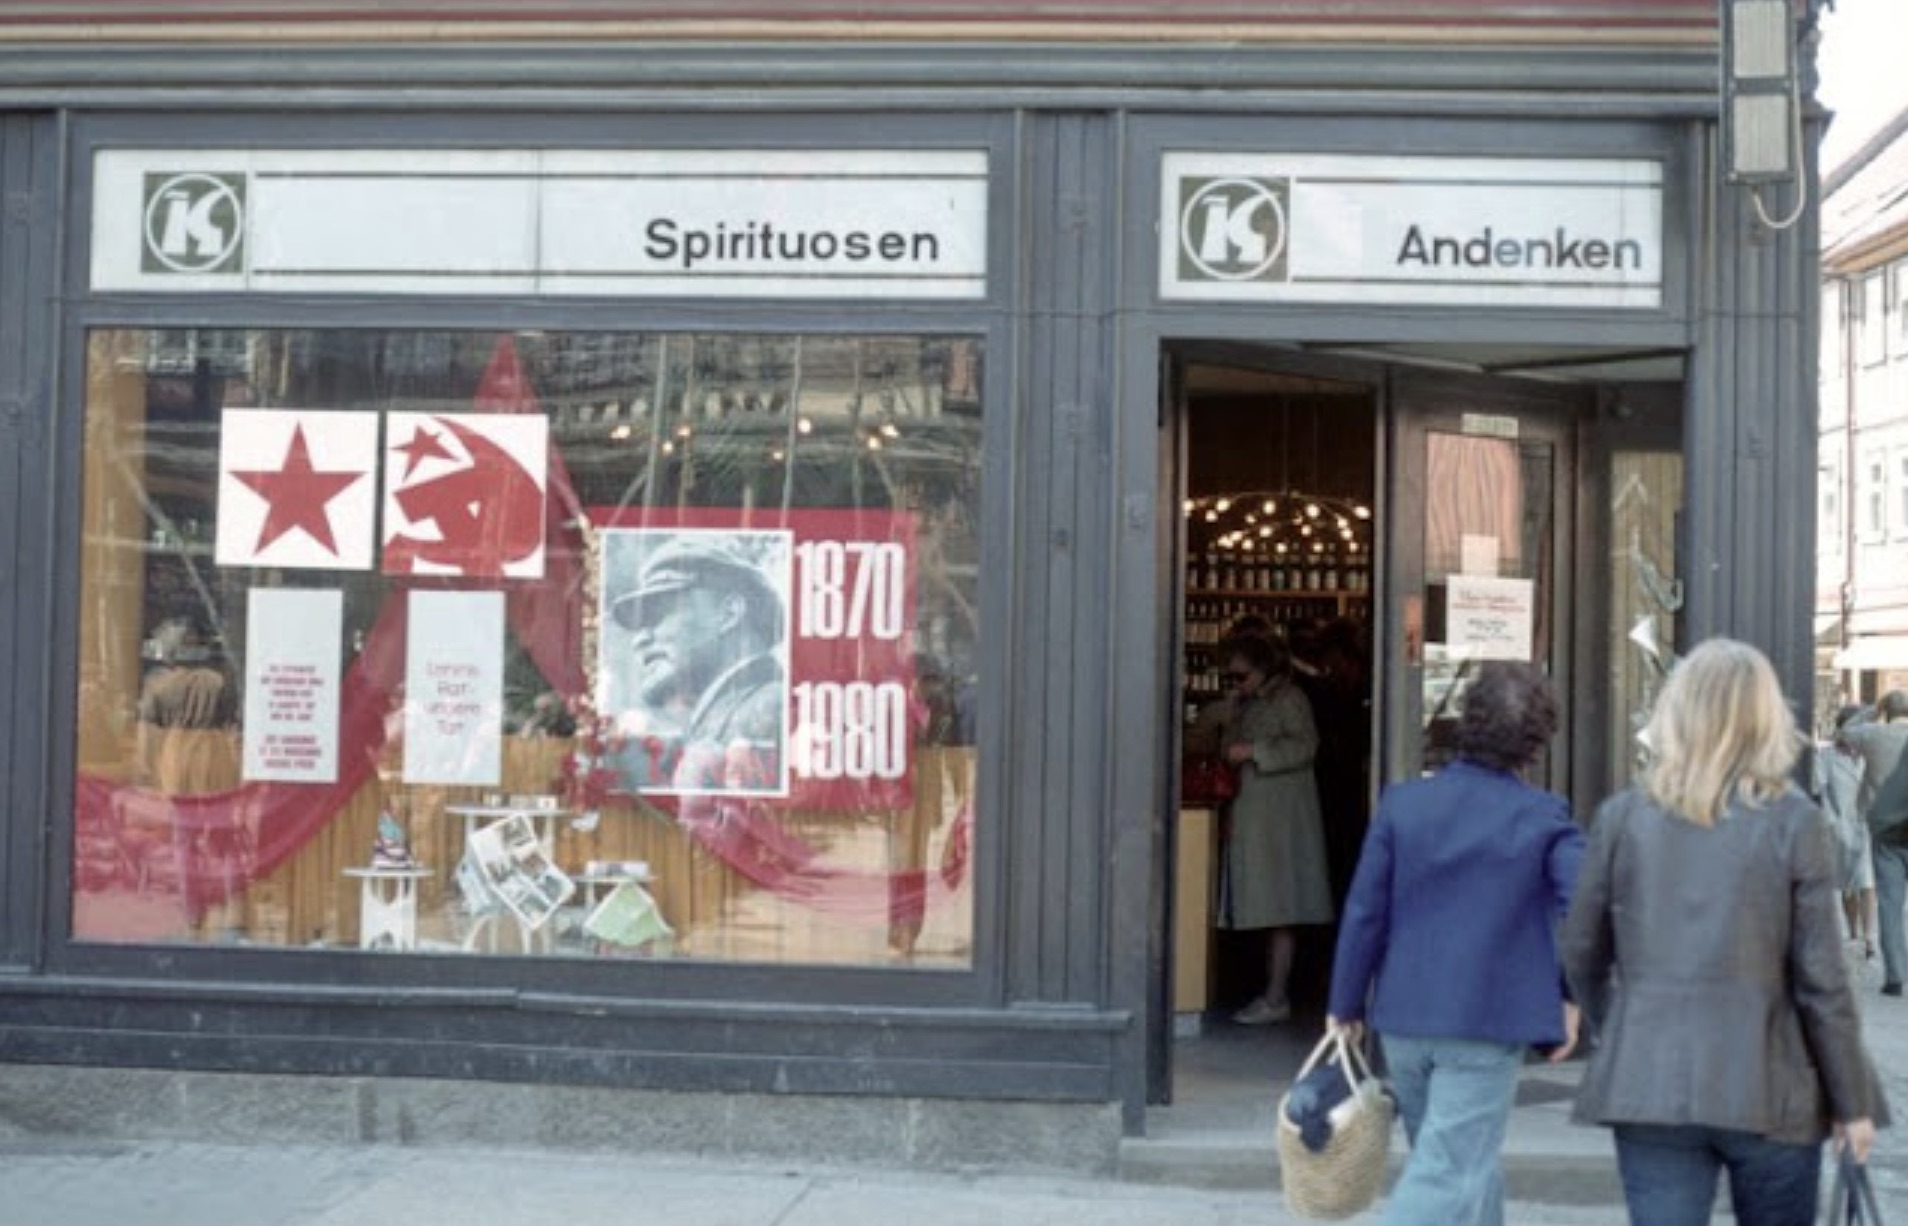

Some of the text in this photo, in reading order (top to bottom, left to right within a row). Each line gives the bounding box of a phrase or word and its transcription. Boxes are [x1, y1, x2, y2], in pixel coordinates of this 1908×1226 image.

[645, 218, 939, 268] Spirituosen
[1397, 224, 1642, 269] Andenken
[796, 541, 905, 640] 1870
[793, 681, 906, 779] 1980
